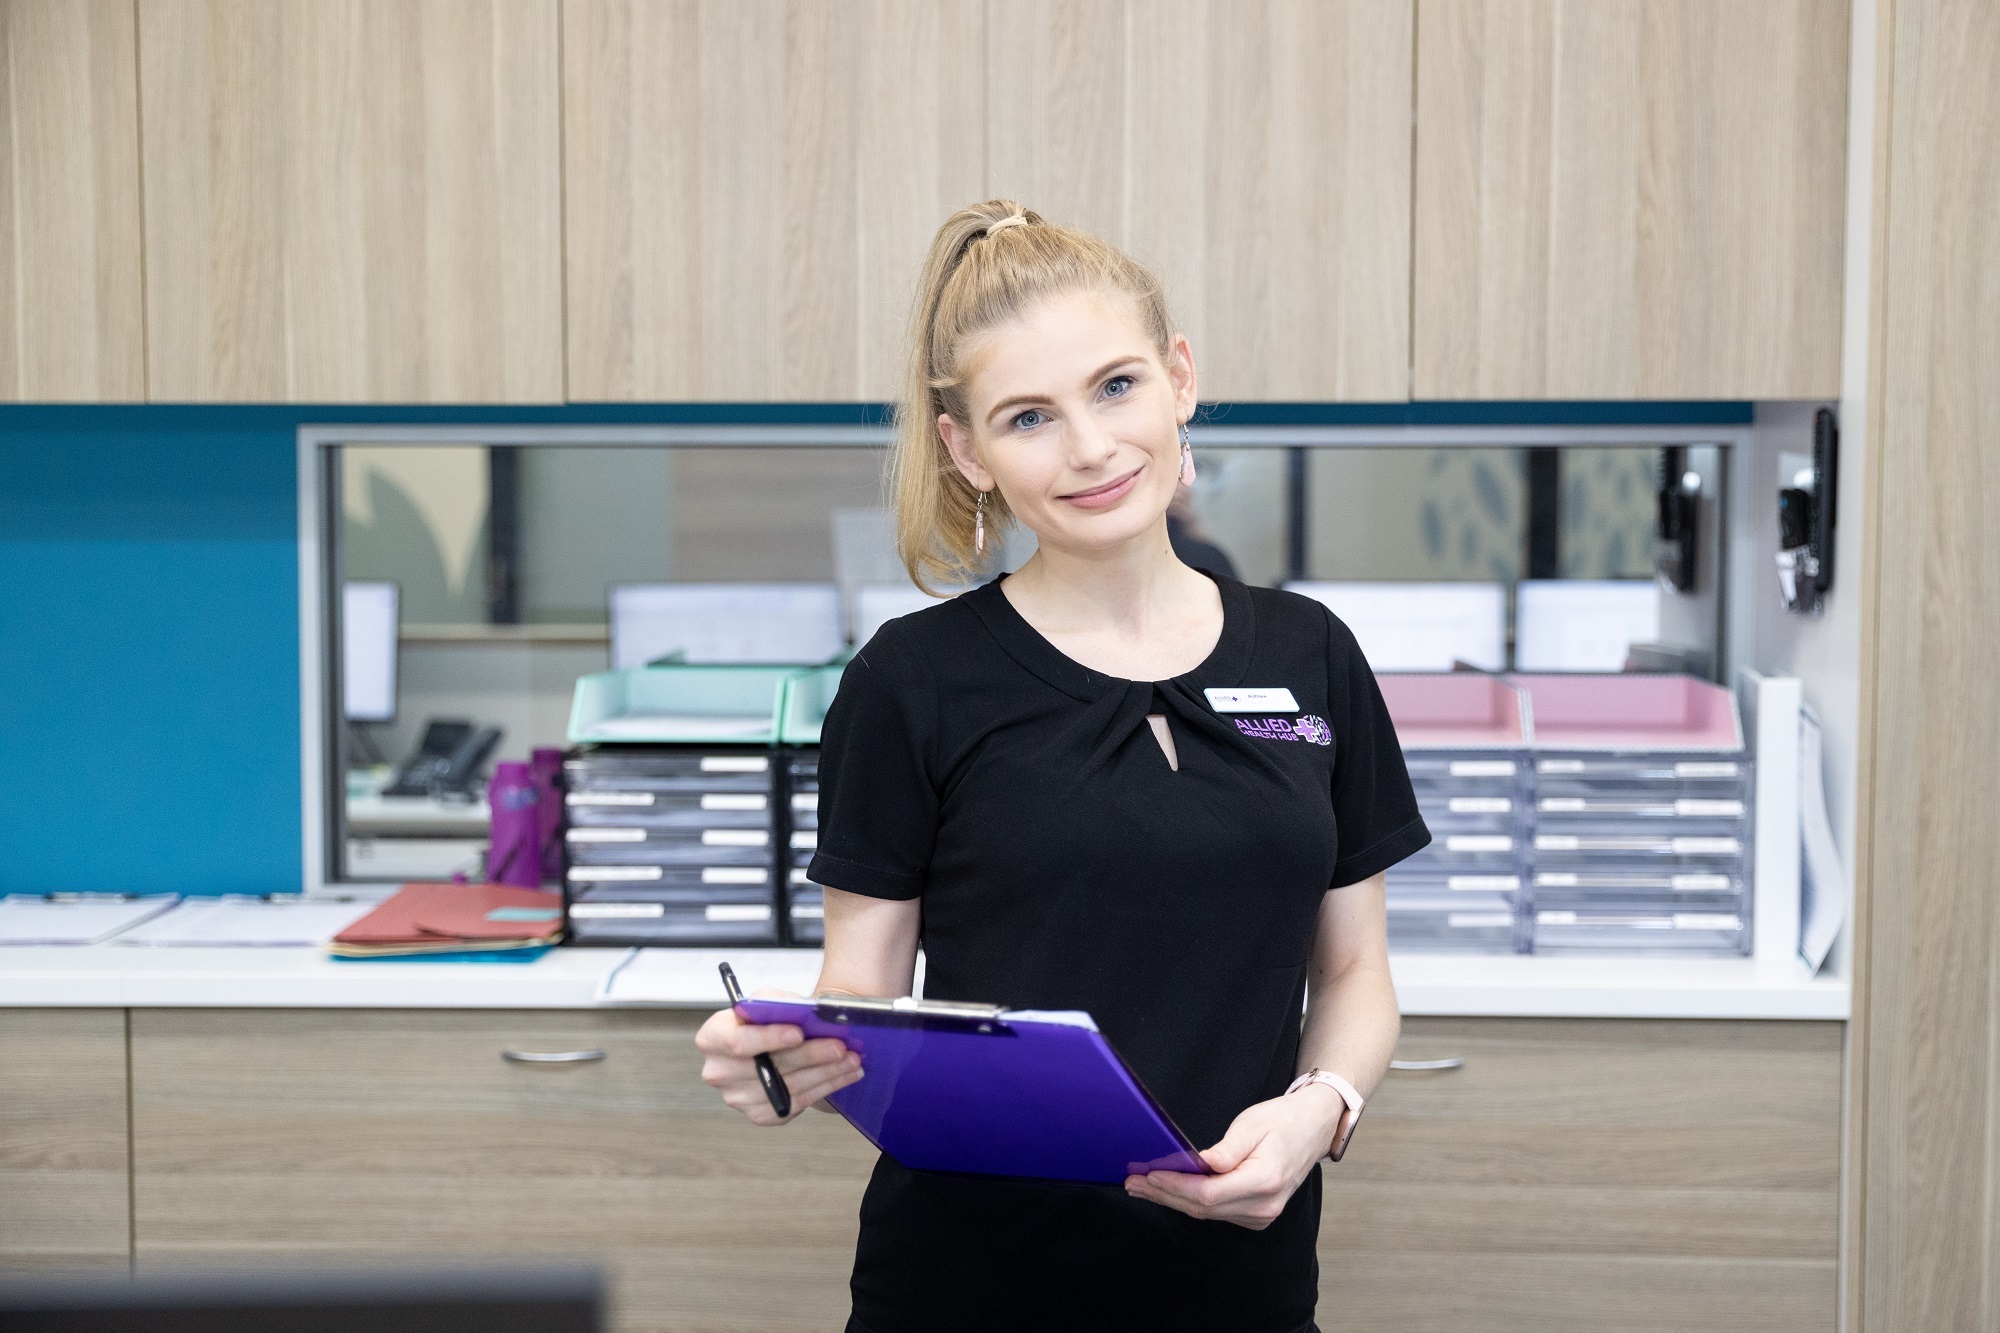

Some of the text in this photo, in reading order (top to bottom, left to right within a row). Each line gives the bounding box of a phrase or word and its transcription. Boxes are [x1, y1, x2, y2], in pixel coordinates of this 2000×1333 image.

[1234, 718, 1292, 732] ALLIED
[1240, 729, 1299, 741] HEALTH HUB
